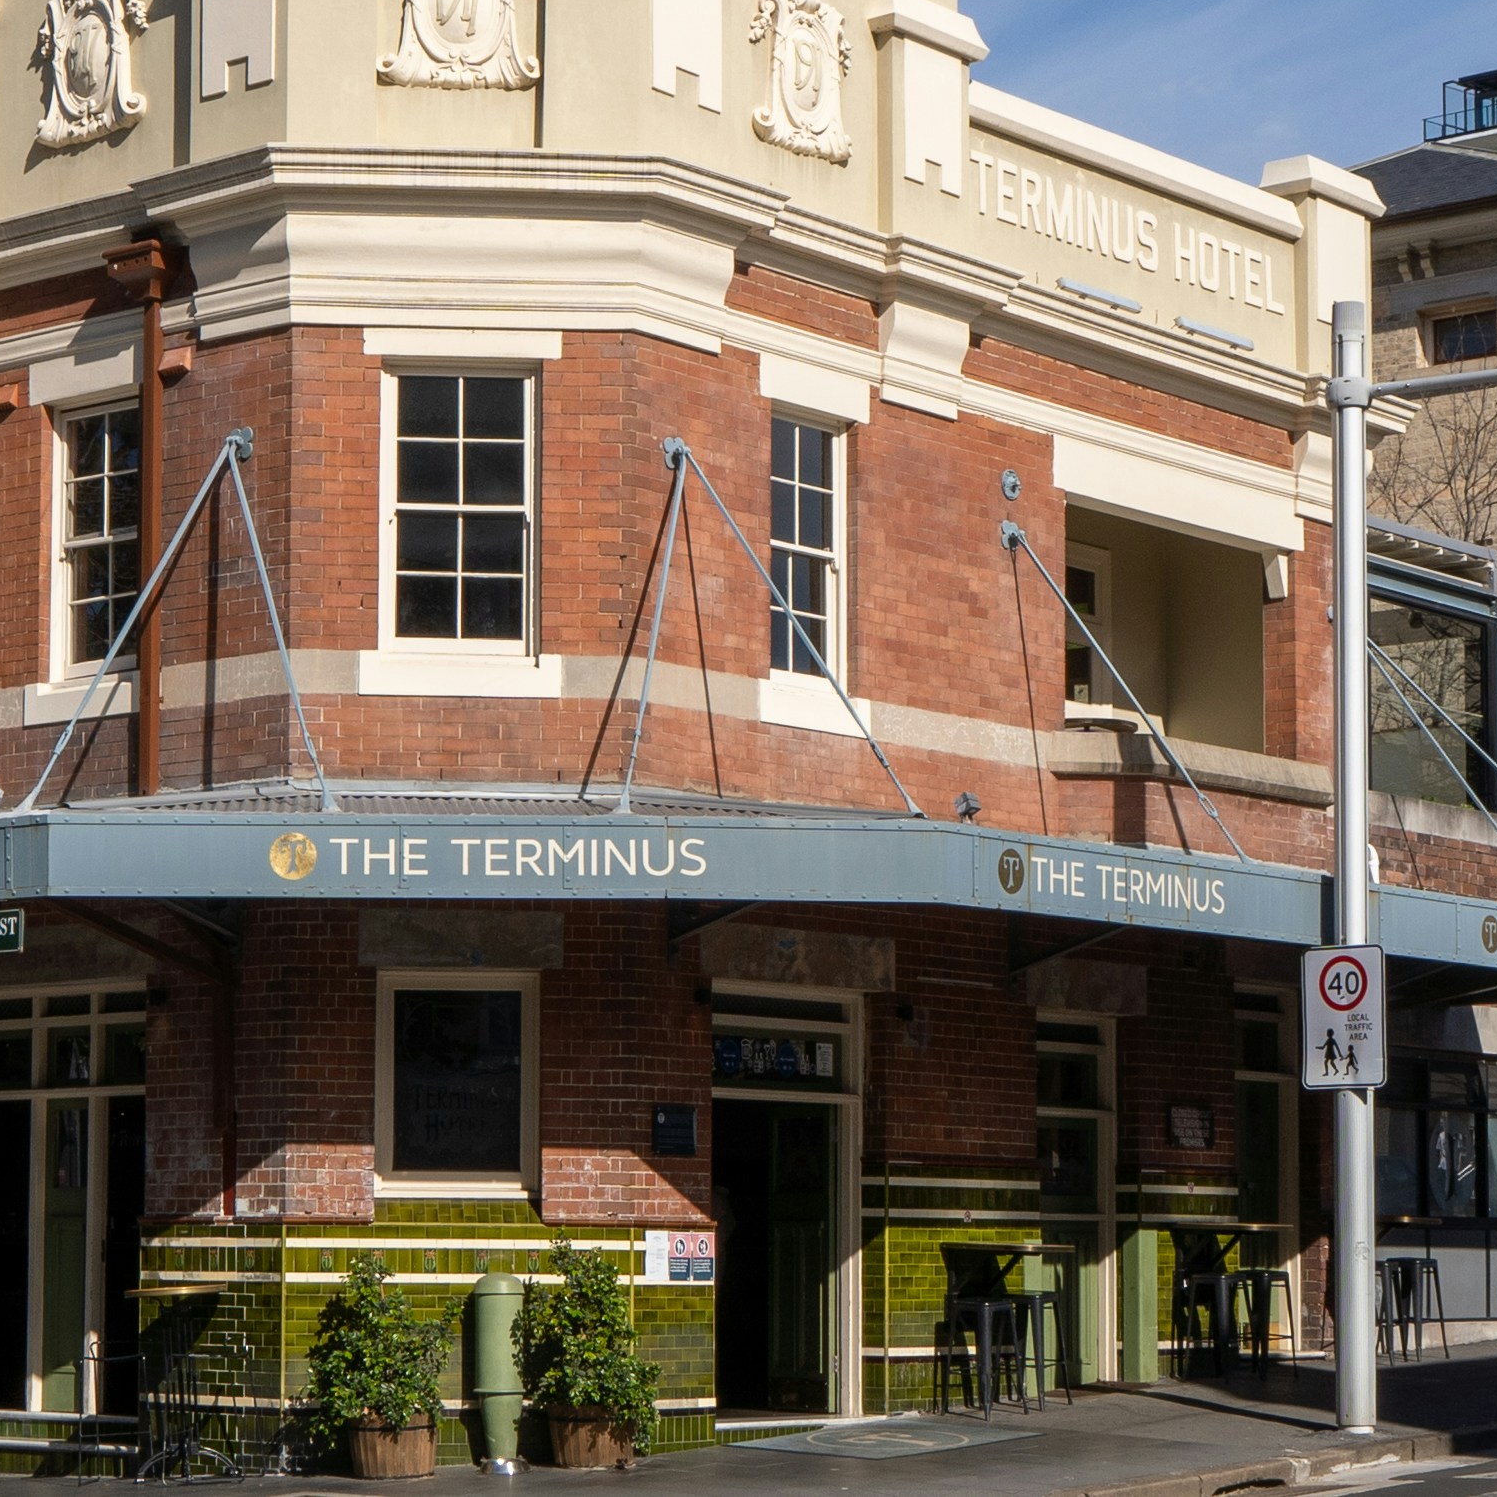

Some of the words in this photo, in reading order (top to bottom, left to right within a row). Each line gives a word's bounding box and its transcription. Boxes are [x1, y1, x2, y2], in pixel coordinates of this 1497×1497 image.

[969, 150, 1159, 273] TERMINUS
[1174, 223, 1285, 315] HOTEL
[330, 838, 429, 876] THE
[451, 837, 707, 876] TERMINUS
[1031, 857, 1086, 897] THE
[1095, 865, 1226, 915] TERMINUS
[0, 916, 17, 936] ST
[1327, 971, 1359, 996] 40
[1344, 1023, 1373, 1031] TRAFFIC
[1347, 1014, 1369, 1022] LOCAL
[1349, 1033, 1368, 1041] AREA
